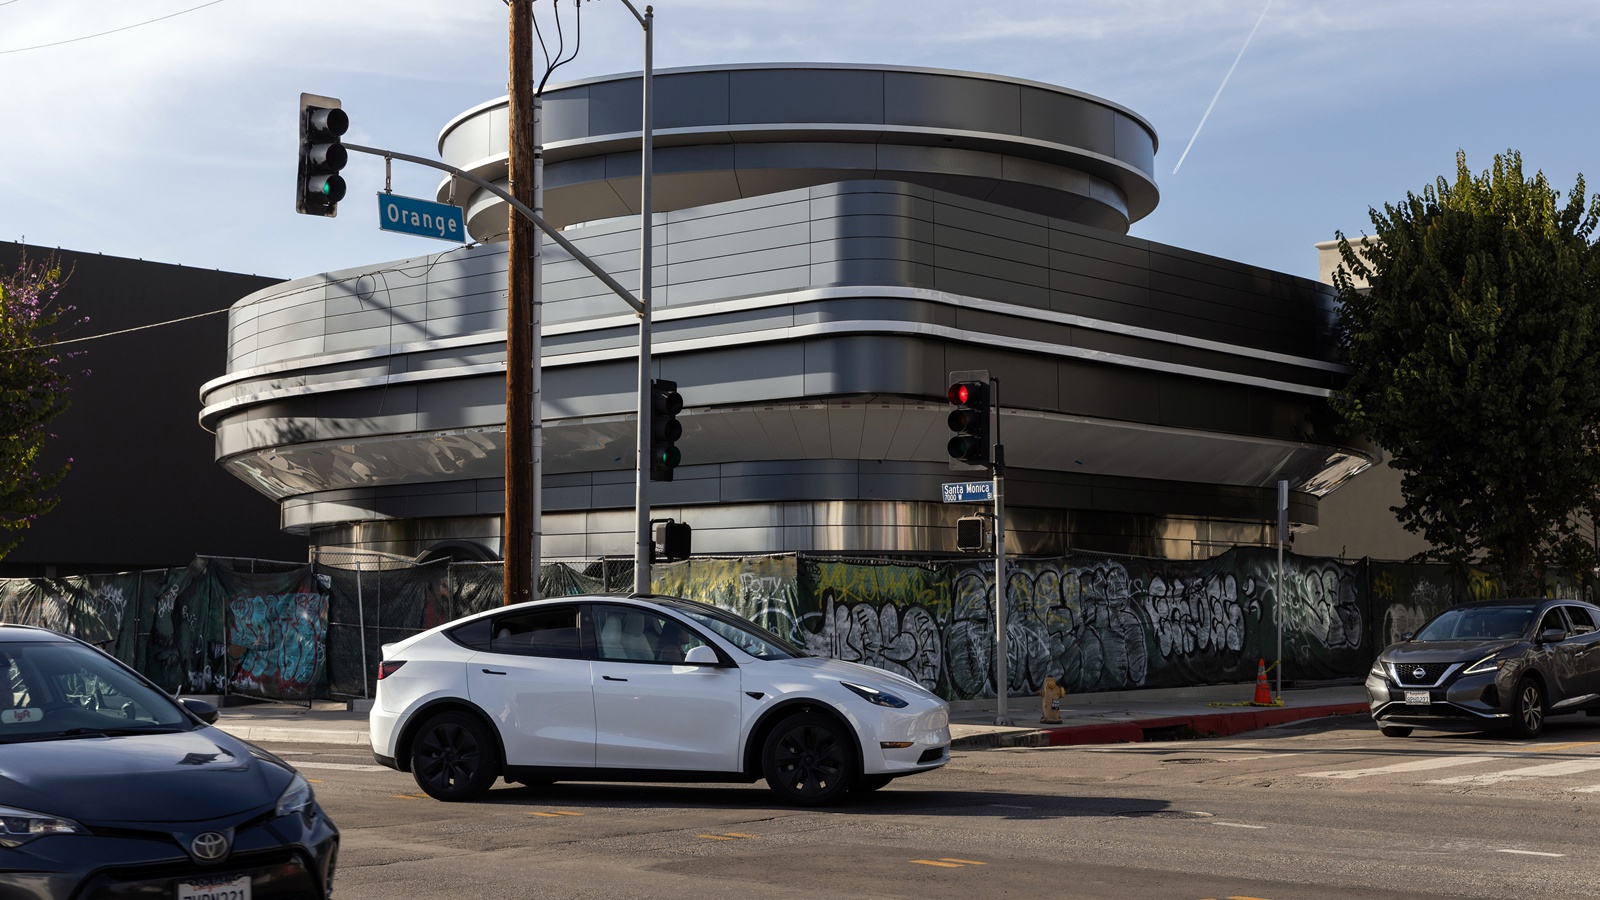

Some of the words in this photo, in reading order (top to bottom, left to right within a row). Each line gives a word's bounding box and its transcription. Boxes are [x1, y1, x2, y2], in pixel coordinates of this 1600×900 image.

[387, 203, 457, 236] Orange
[944, 485, 963, 494] Santa
[967, 484, 989, 493] Monica
